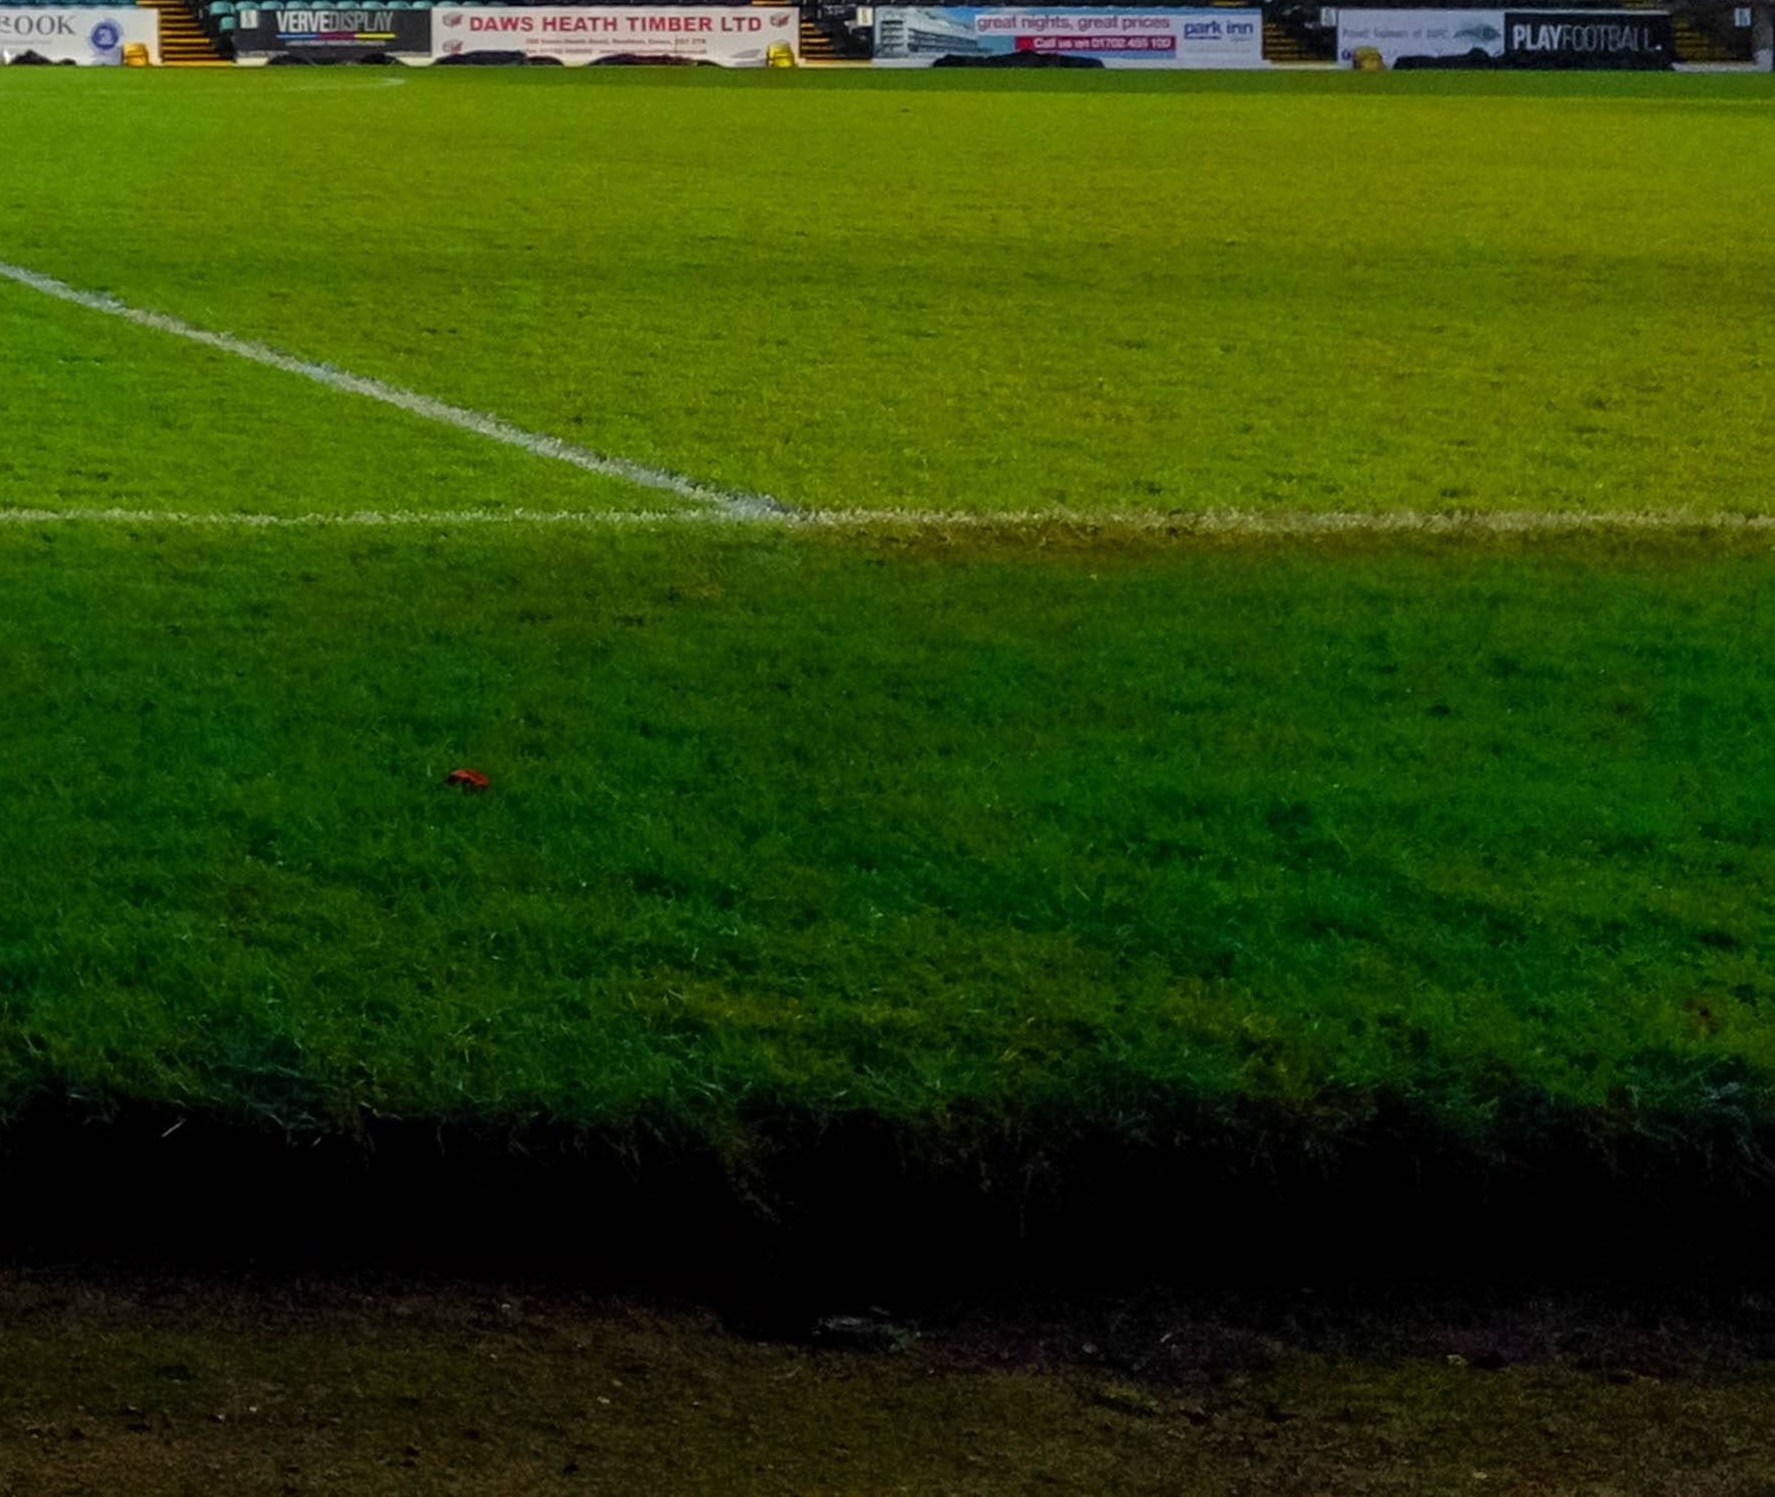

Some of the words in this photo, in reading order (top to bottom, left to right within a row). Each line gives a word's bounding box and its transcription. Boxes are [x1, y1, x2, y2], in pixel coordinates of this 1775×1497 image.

[469, 16, 534, 33] DAWS
[542, 17, 618, 32] HEATH
[626, 17, 713, 32] TIMBER
[721, 17, 763, 32] LTD
[977, 15, 1016, 32] great
[1078, 15, 1118, 32] great
[1122, 15, 1171, 32] prices
[1184, 19, 1223, 39] park
[1226, 19, 1254, 35] inn
